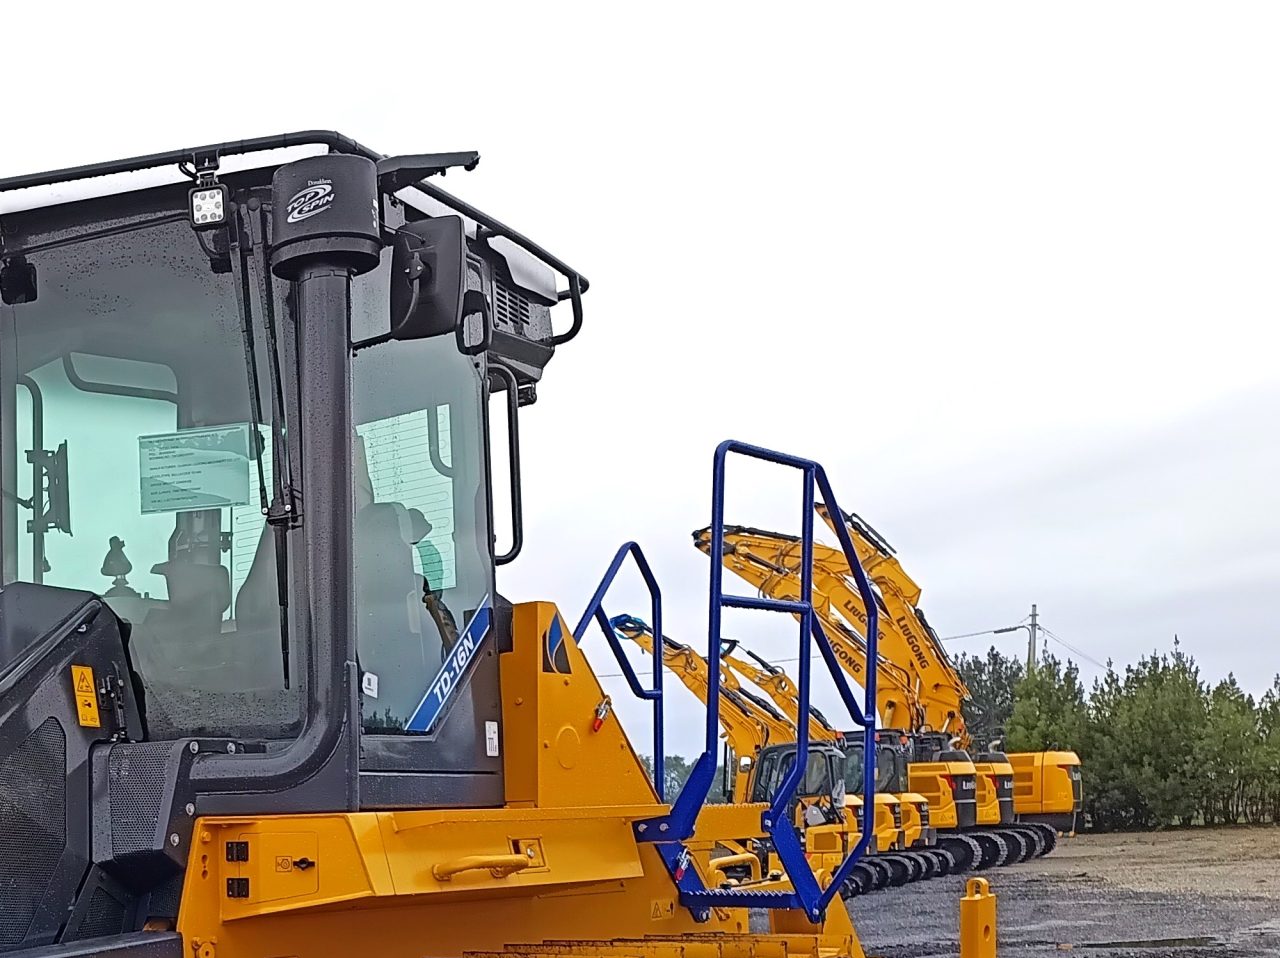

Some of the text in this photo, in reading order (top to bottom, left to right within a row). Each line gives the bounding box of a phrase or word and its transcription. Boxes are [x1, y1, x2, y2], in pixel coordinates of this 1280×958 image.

[287, 192, 315, 213] TOP
[301, 193, 335, 214] SPIN
[843, 600, 886, 641] LIUGG
[896, 615, 930, 670] LIUGONG
[432, 631, 475, 704] TD-16N
